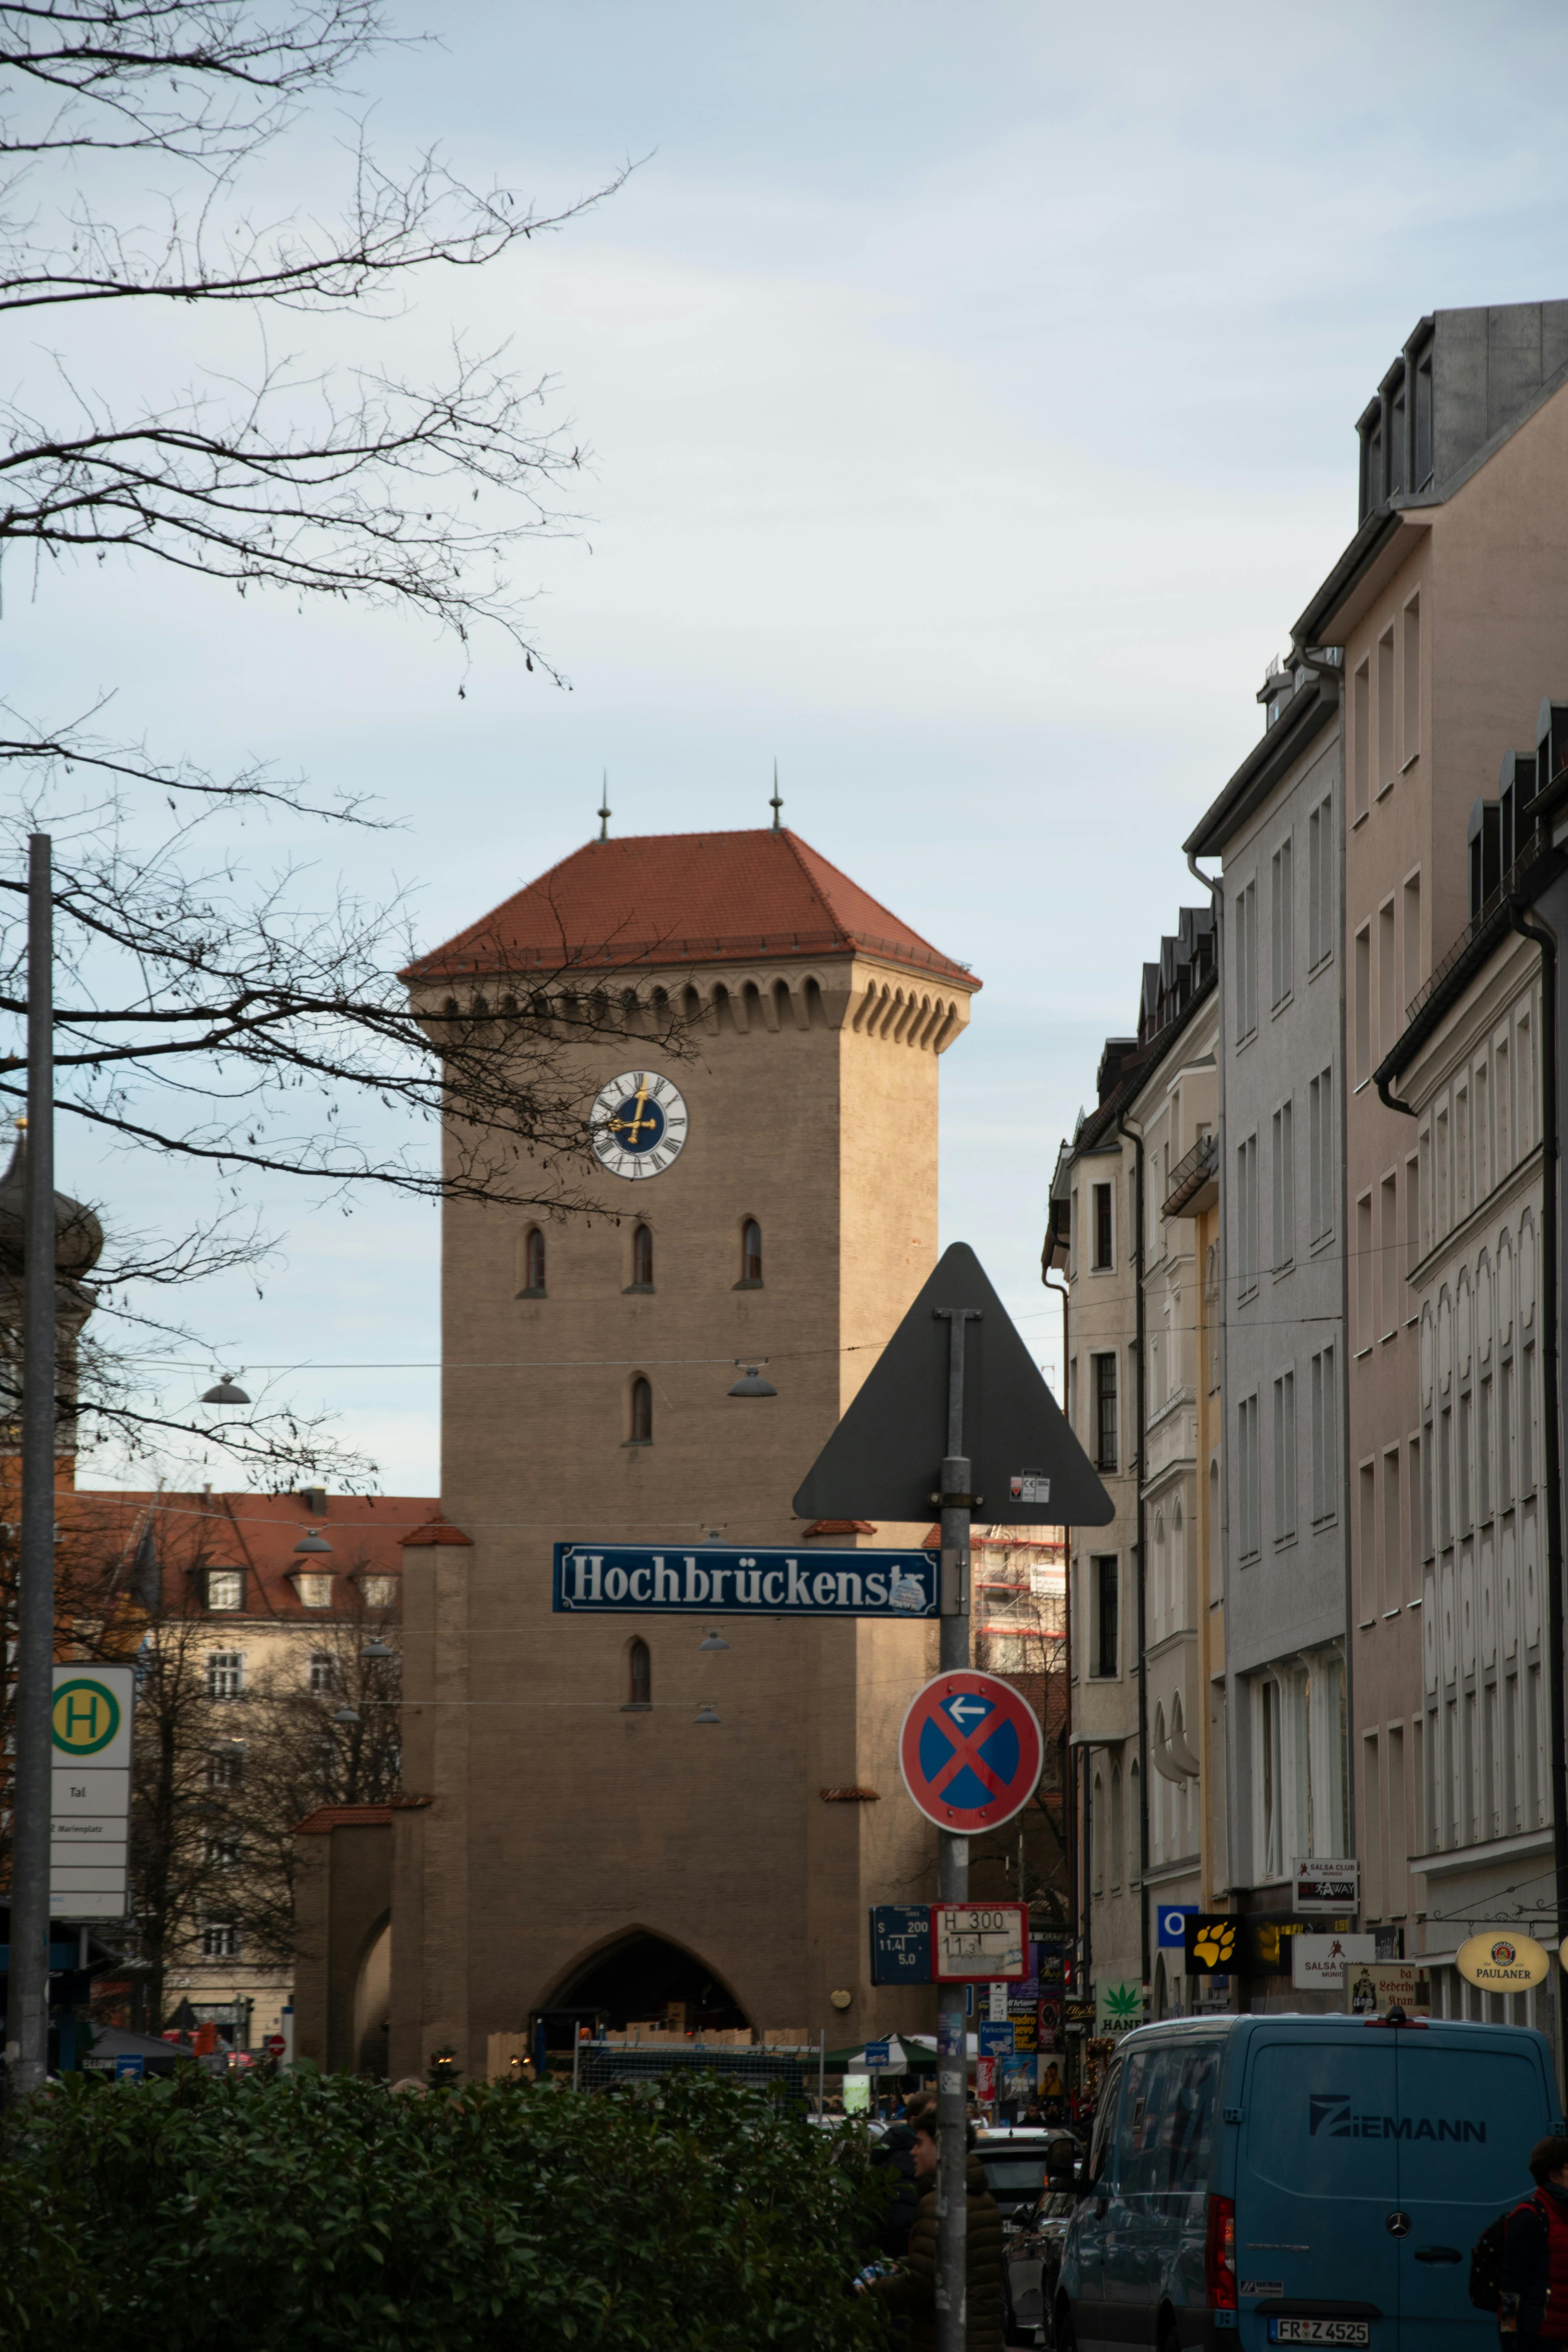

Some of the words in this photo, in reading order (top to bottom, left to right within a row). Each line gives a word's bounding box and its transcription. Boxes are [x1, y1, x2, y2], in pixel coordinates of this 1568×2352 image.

[65, 1696, 97, 1738] H
[70, 1787, 86, 1797] Tal
[58, 1825, 102, 1834] Marienplatz
[945, 1912, 955, 1929] H
[970, 1912, 1003, 1929] 300
[878, 1922, 885, 1933] S
[908, 1922, 928, 1933] 200
[879, 1939, 901, 1951] 11.4
[1305, 1962, 1336, 1970] SALSA
[1476, 1969, 1531, 1979] PAULANER
[1015, 2026, 1034, 2035] uevo
[1245, 2243, 1309, 2252] SPRINTER
[1279, 2321, 1301, 2338] FR
[1312, 2322, 1322, 2339] Z
[1326, 2324, 1366, 2341] 4525
